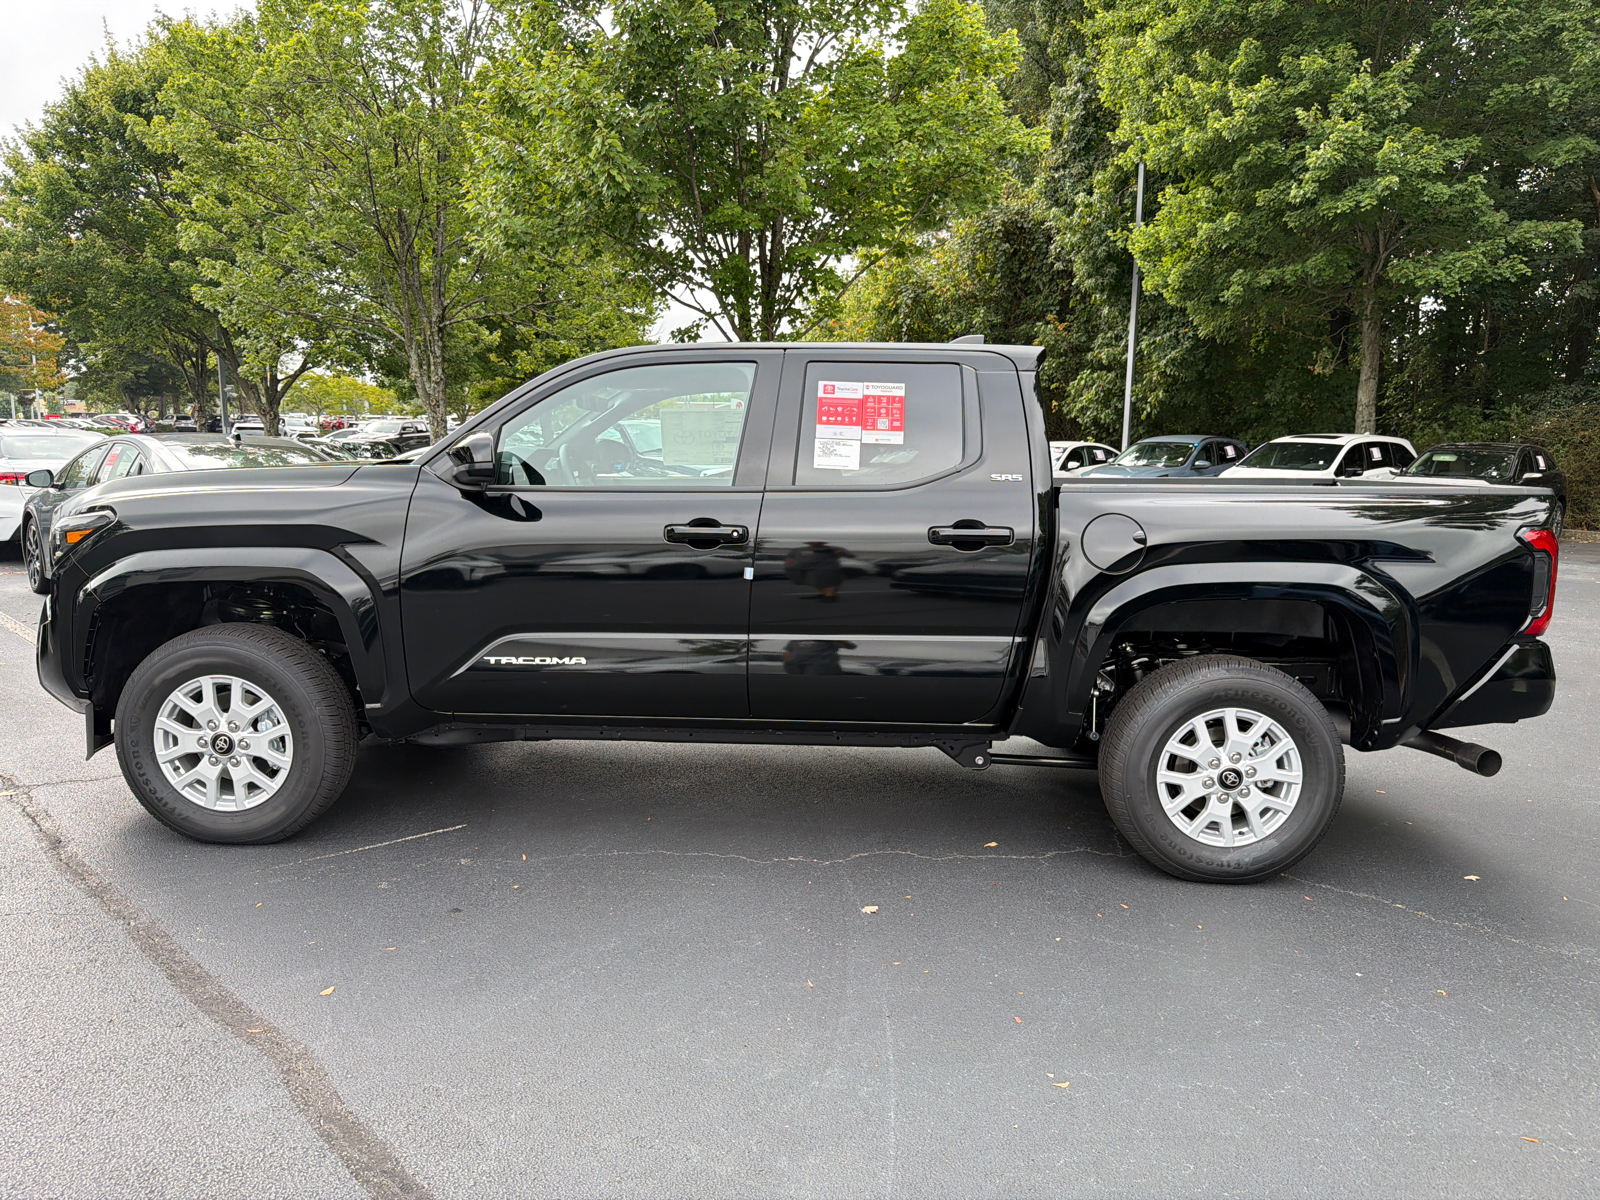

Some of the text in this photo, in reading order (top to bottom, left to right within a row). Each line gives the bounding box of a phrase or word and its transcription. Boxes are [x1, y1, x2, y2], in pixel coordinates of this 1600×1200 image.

[990, 473, 1023, 482] SR5
[483, 656, 587, 665] TACOMA
[1222, 687, 1306, 726] Firestone
[129, 738, 180, 818] Firestone
